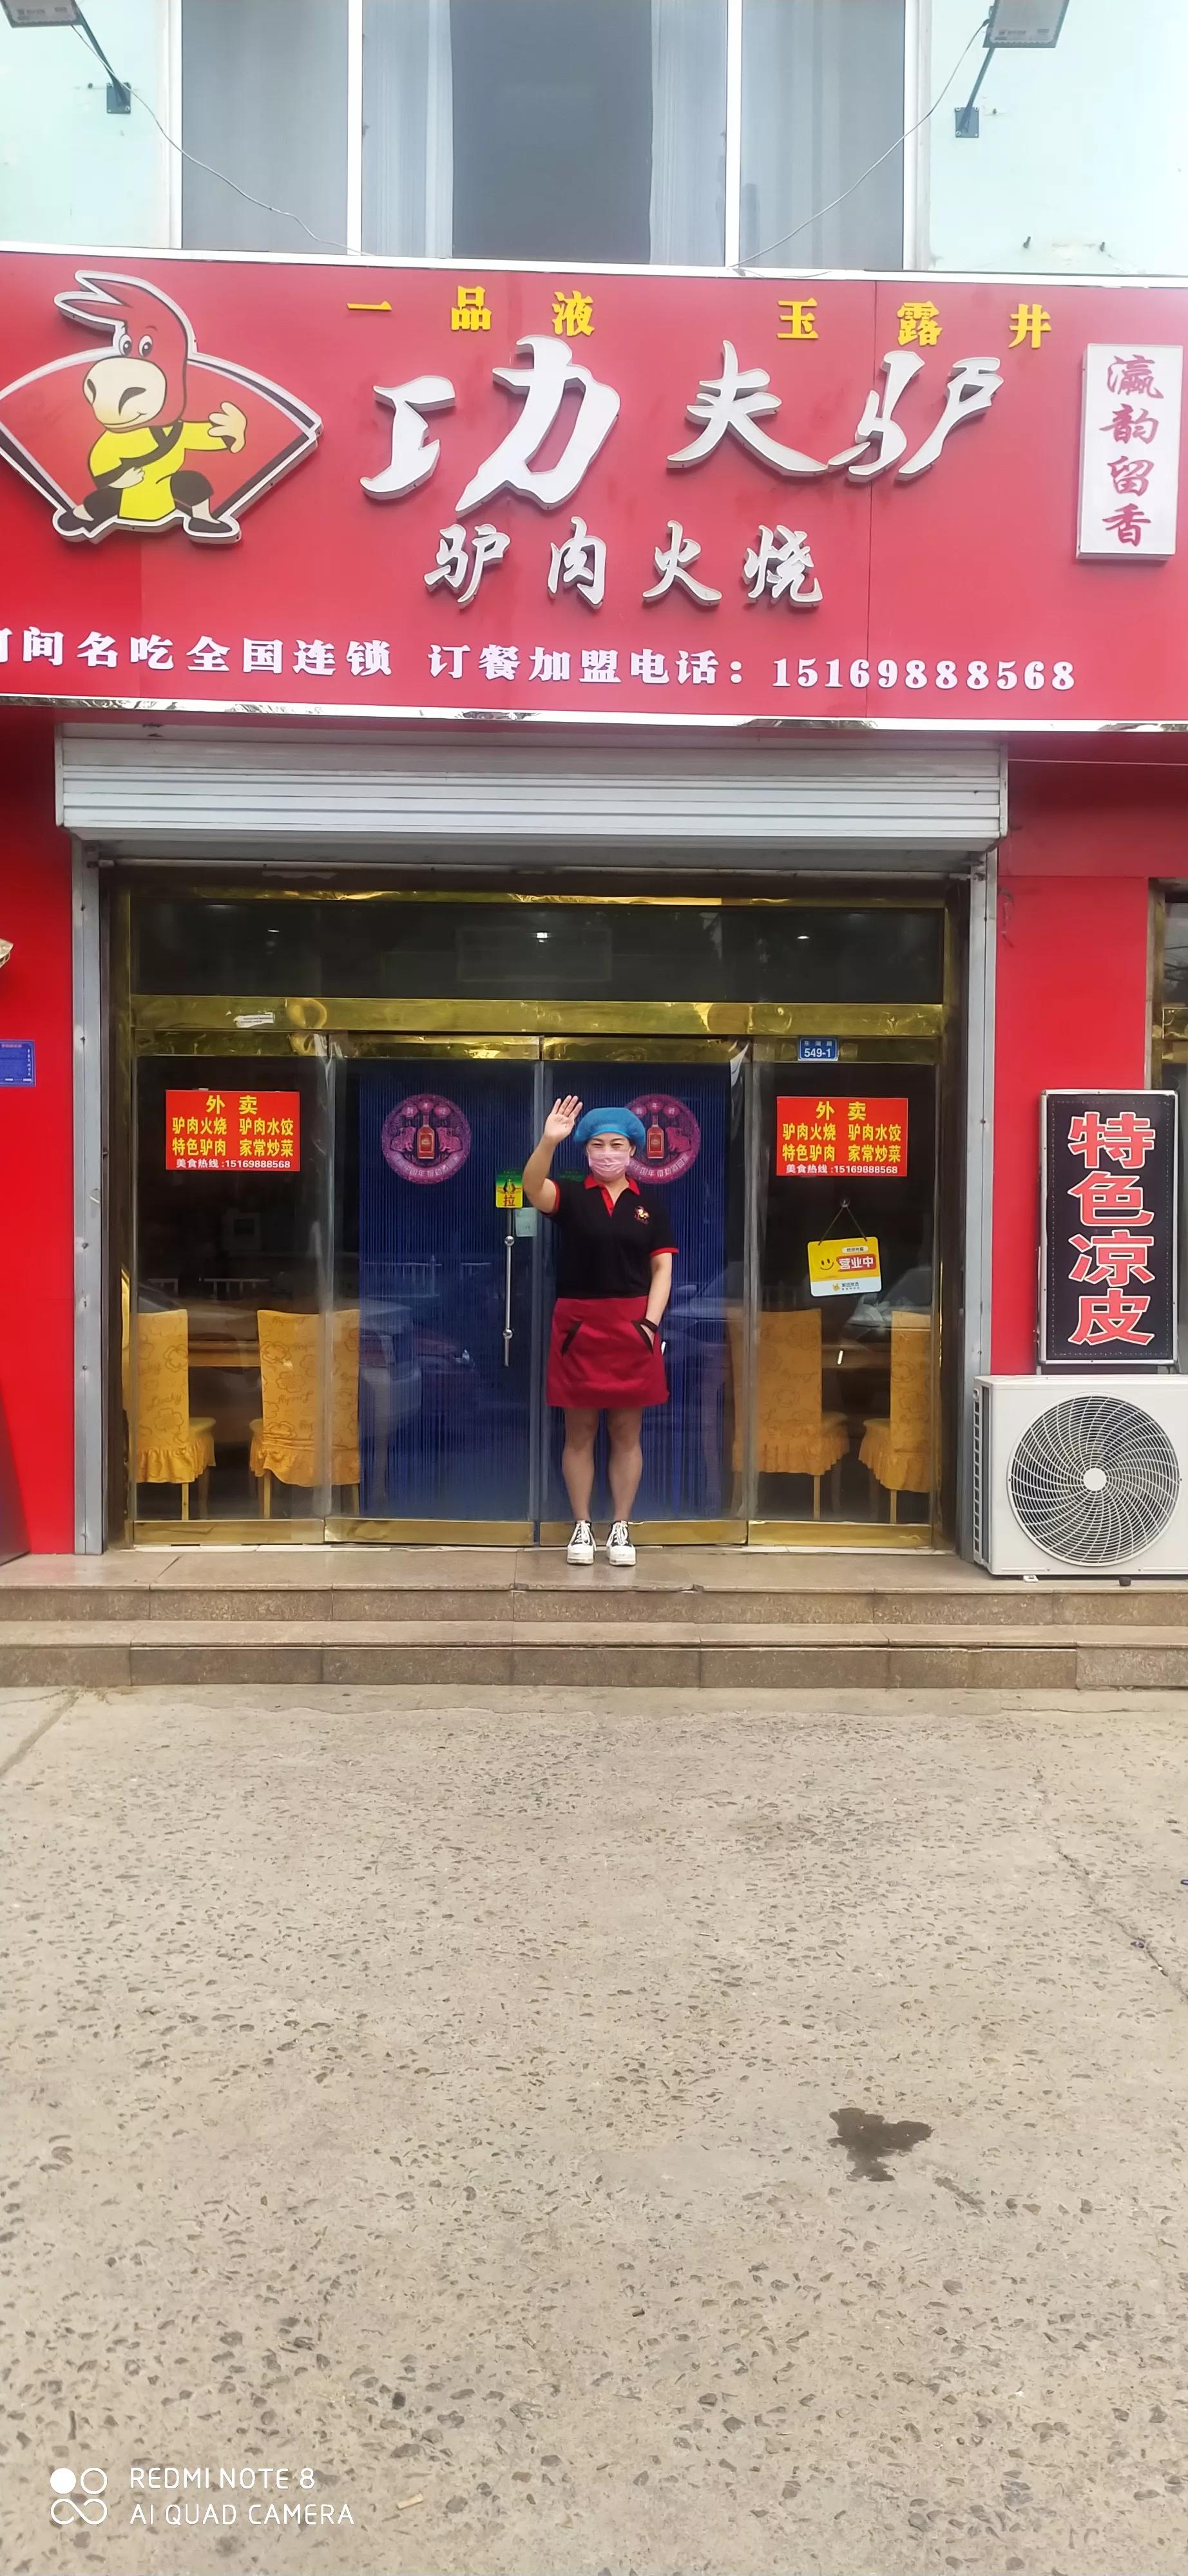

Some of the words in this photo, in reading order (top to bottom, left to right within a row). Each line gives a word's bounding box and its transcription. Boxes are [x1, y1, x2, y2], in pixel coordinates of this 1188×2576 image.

[1099, 354, 1164, 547] 瀛韵留香
[423, 516, 823, 611] 驴肉火烧
[772, 658, 1075, 690] 15169888568
[804, 1048, 831, 1057] 549-1
[206, 1095, 258, 1115] 外卖
[816, 1101, 867, 1121] 外卖
[172, 1117, 227, 1135] 驴肉火烧
[239, 1118, 294, 1136] 驴肉水饺
[782, 1123, 836, 1141] 驴肉火烧
[848, 1124, 901, 1141] 驴肉水饺
[172, 1137, 226, 1156] 特色驴肉
[240, 1139, 294, 1157] 家常炒菜
[782, 1144, 835, 1162] 特色驴肉
[848, 1144, 901, 1162] 家常炒菜
[1068, 1111, 1156, 1346] 特色凉皮
[838, 1256, 874, 1270] 营业中
